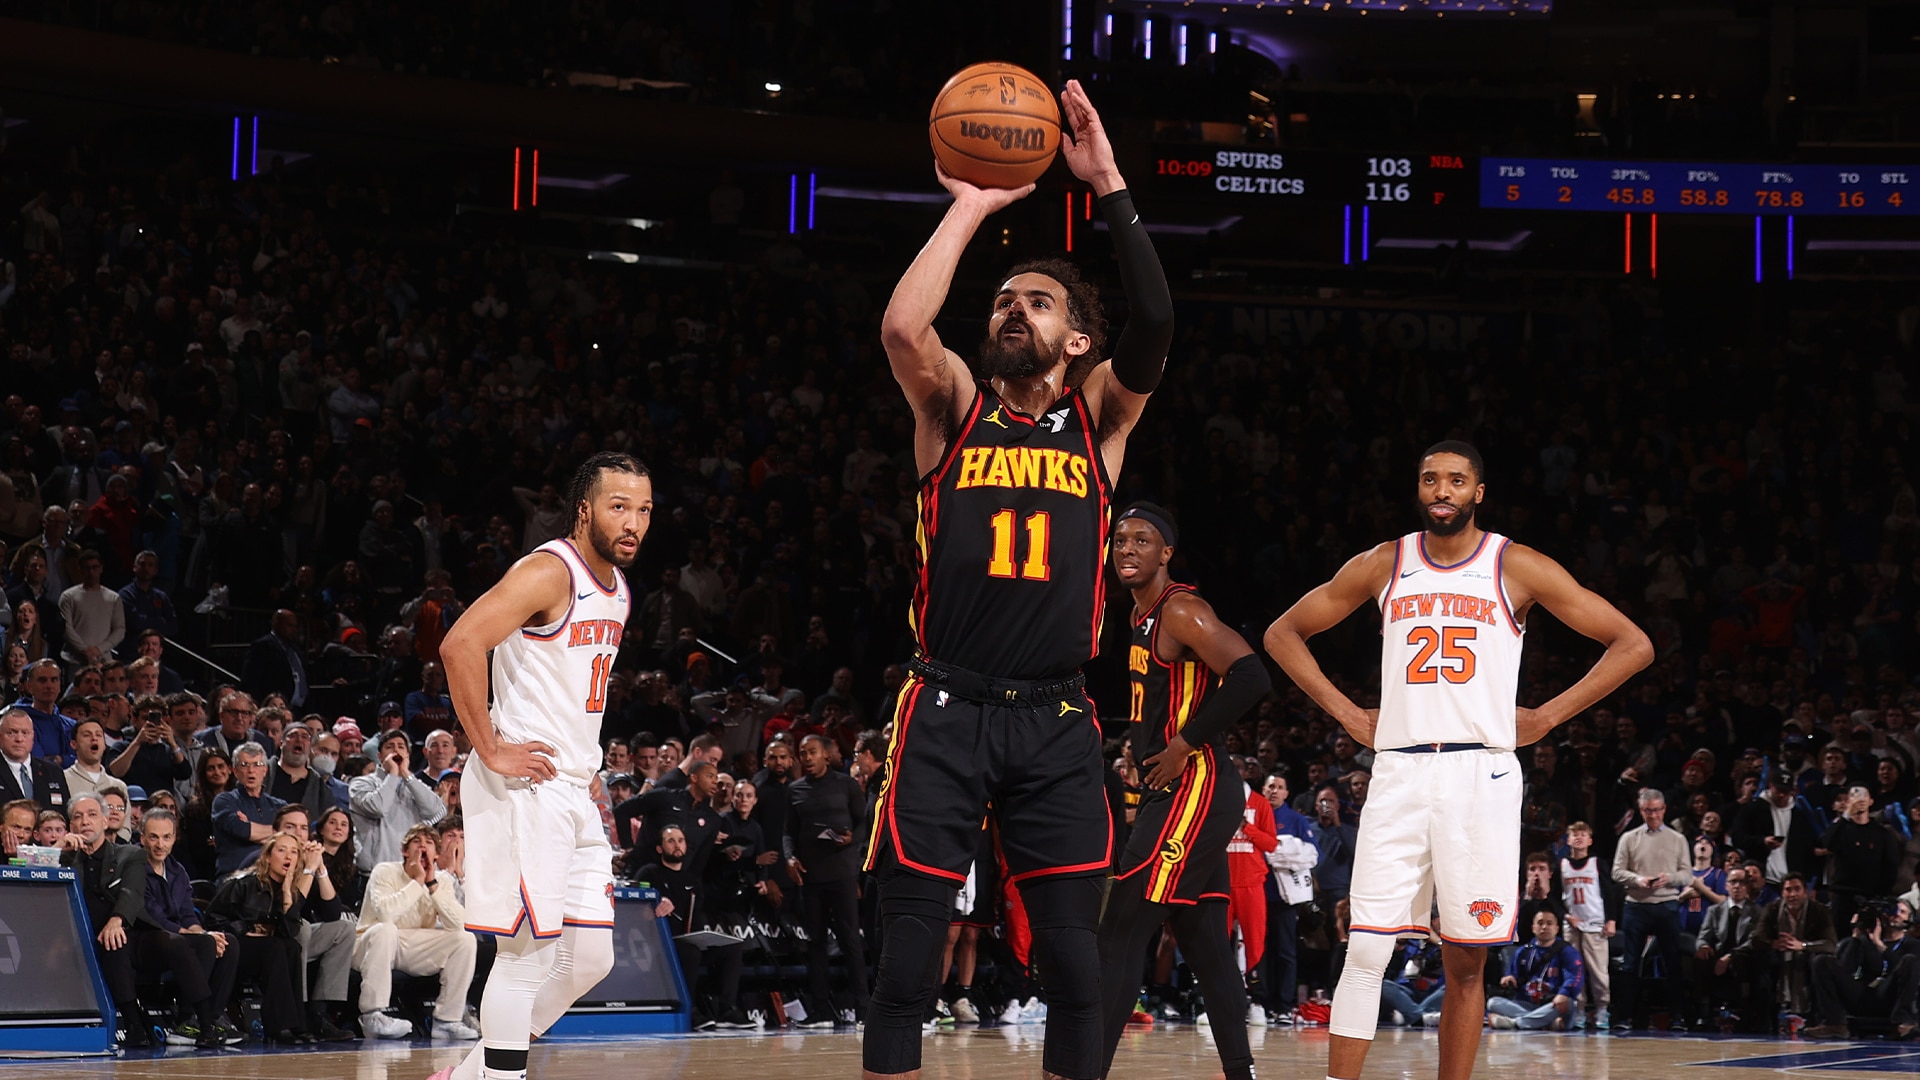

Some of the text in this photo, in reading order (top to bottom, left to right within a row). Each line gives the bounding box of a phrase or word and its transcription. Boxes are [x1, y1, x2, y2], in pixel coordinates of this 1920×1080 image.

[960, 120, 1046, 151] Wilson
[1156, 159, 1213, 177] 10:09
[1216, 151, 1412, 178] SPURS 103
[1430, 155, 1464, 170] NBA
[1499, 166, 1910, 185] FLS TOL 3PT% FG% FT% TO STL
[1215, 176, 1411, 202] CELTICS 116
[1433, 192, 1445, 206] F
[1506, 185, 1903, 208] 5 2 45.8 58.8 78.8 16 4
[955, 445, 1088, 499] HAWKS
[988, 508, 1051, 582] 11
[1390, 592, 1497, 626] NEW YORK
[568, 619, 608, 647] NEW
[1406, 626, 1477, 684] 25
[586, 653, 612, 714] 11
[2, 870, 76, 880] CHASE CHASE CHASE
[1469, 900, 1504, 915] KNICKS
[1573, 887, 1585, 905] 11
